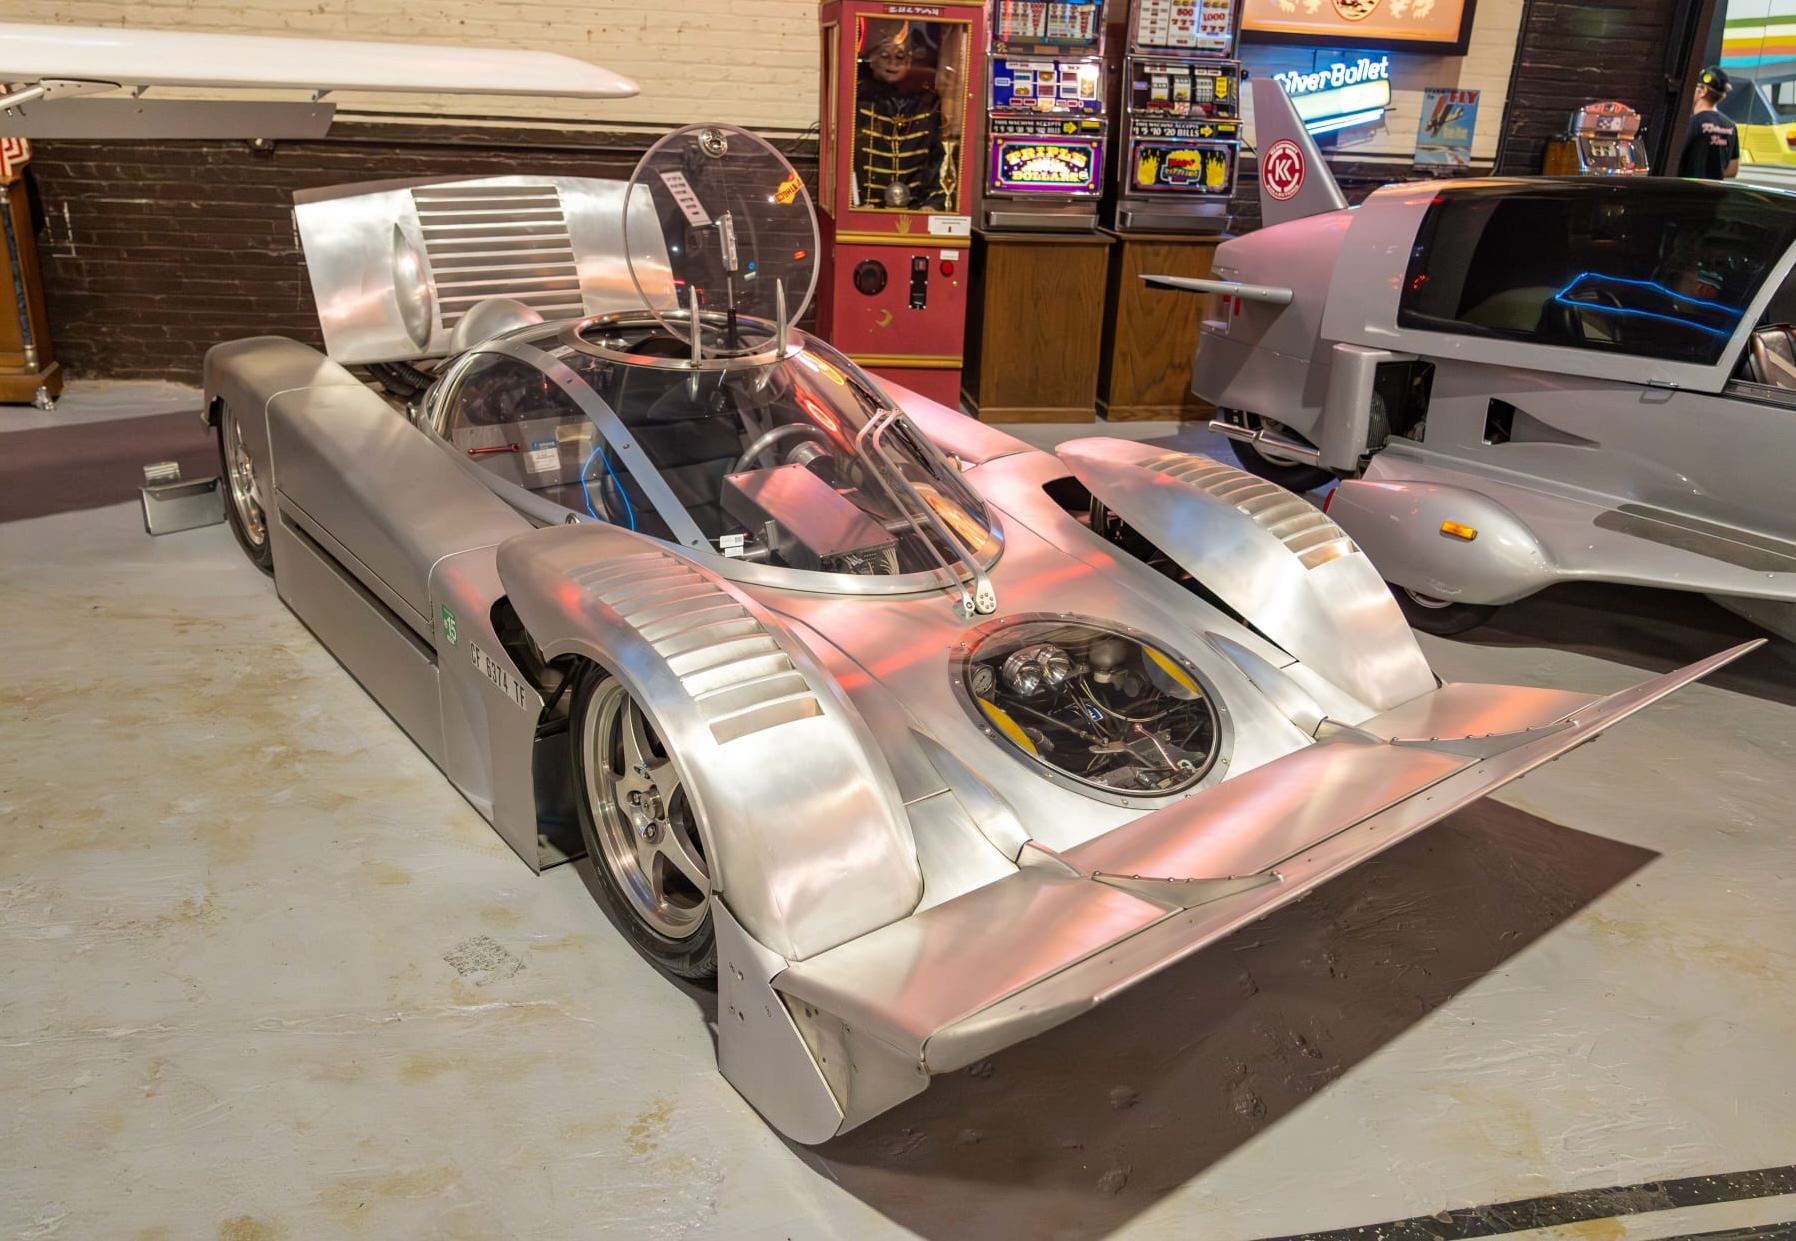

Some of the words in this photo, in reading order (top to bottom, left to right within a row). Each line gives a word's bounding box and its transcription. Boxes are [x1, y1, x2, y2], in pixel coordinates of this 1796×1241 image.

[1330, 55, 1389, 88] Bullet
[1449, 89, 1480, 105] FLY
[1177, 129, 1200, 137] BILLS
[1006, 147, 1087, 168] TRIPLE
[470, 642, 480, 667] CF
[486, 656, 508, 693] 6374
[513, 680, 525, 708] TF
